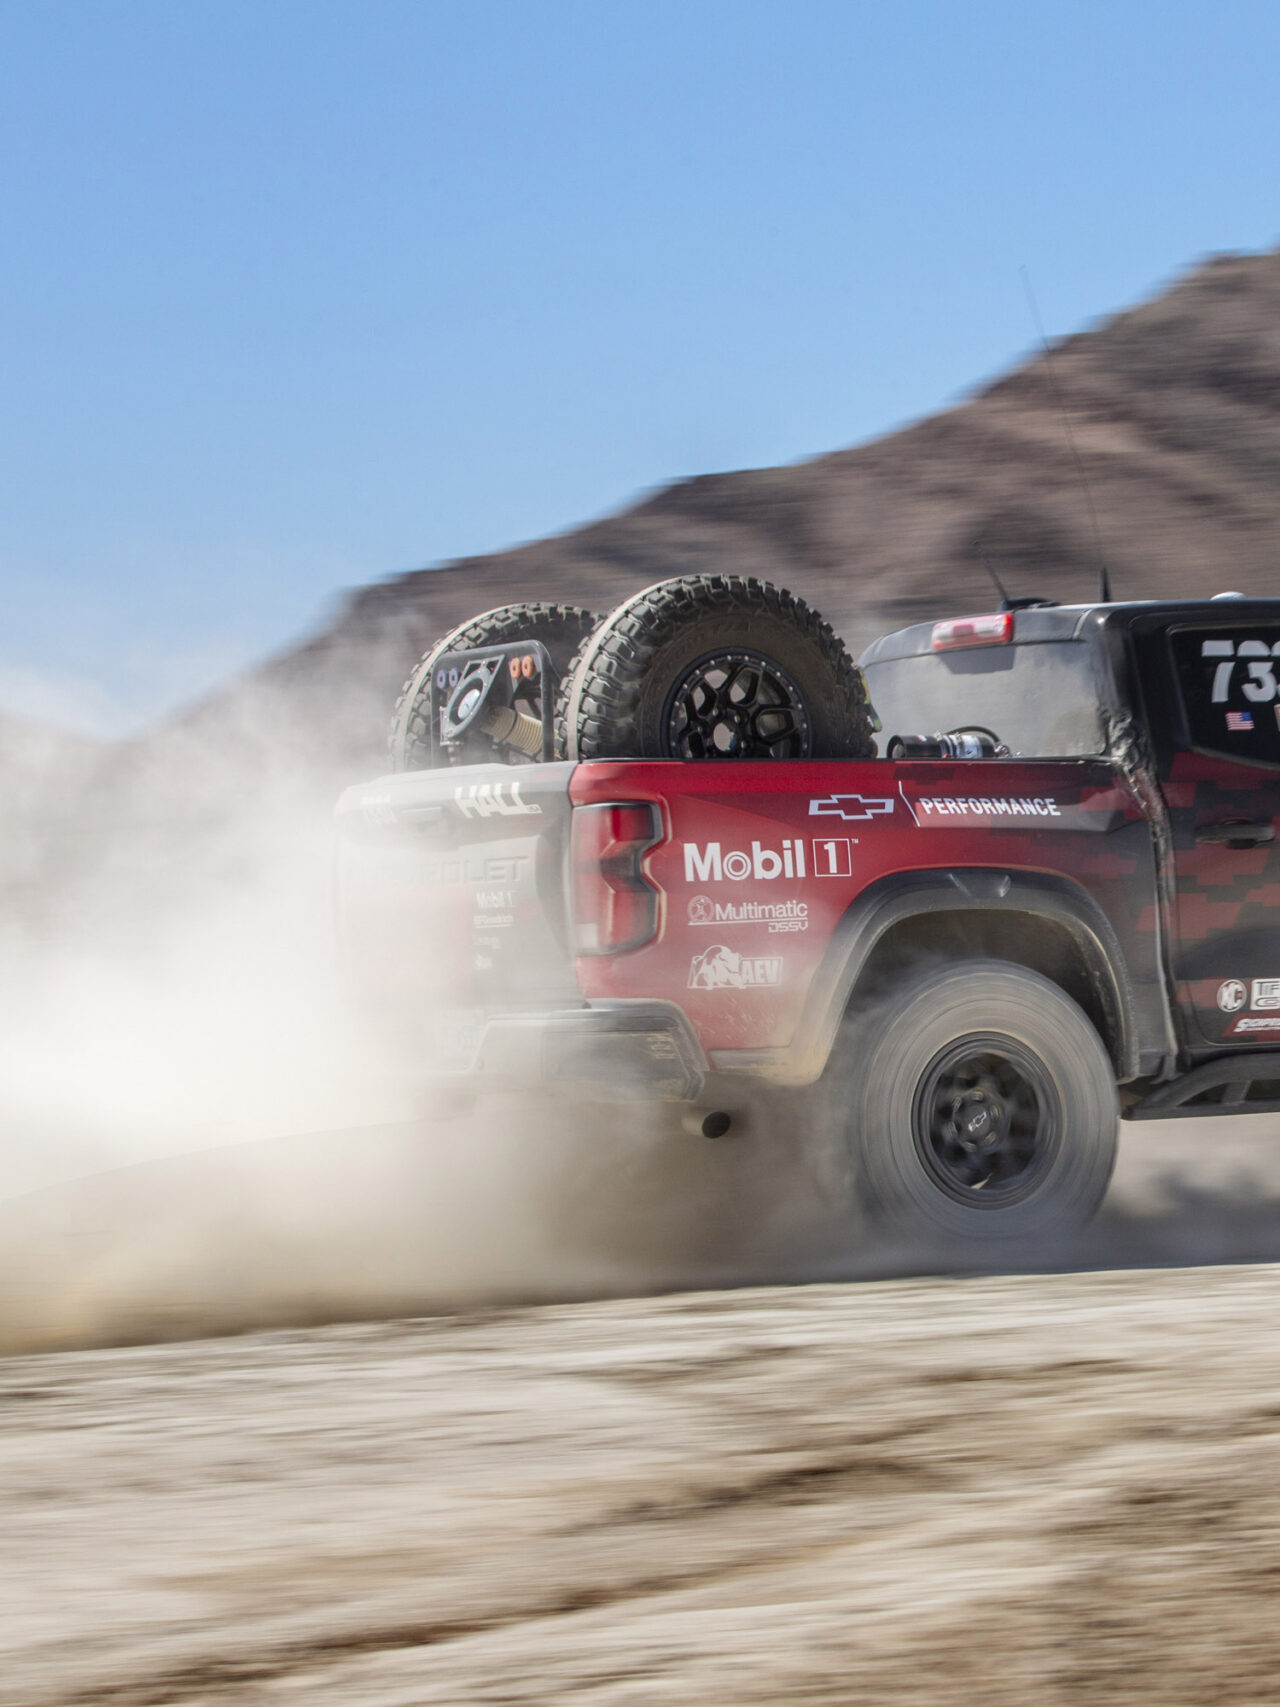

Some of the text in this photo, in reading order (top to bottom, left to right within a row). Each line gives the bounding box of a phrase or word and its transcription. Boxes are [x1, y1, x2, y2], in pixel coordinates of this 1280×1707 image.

[454, 782, 542, 818] HALL
[919, 797, 1062, 816] PERFORMANCE
[684, 839, 807, 882] Mobil
[715, 900, 809, 921] Multimatic
[768, 920, 809, 933] DSSV
[741, 959, 779, 984] AEV
